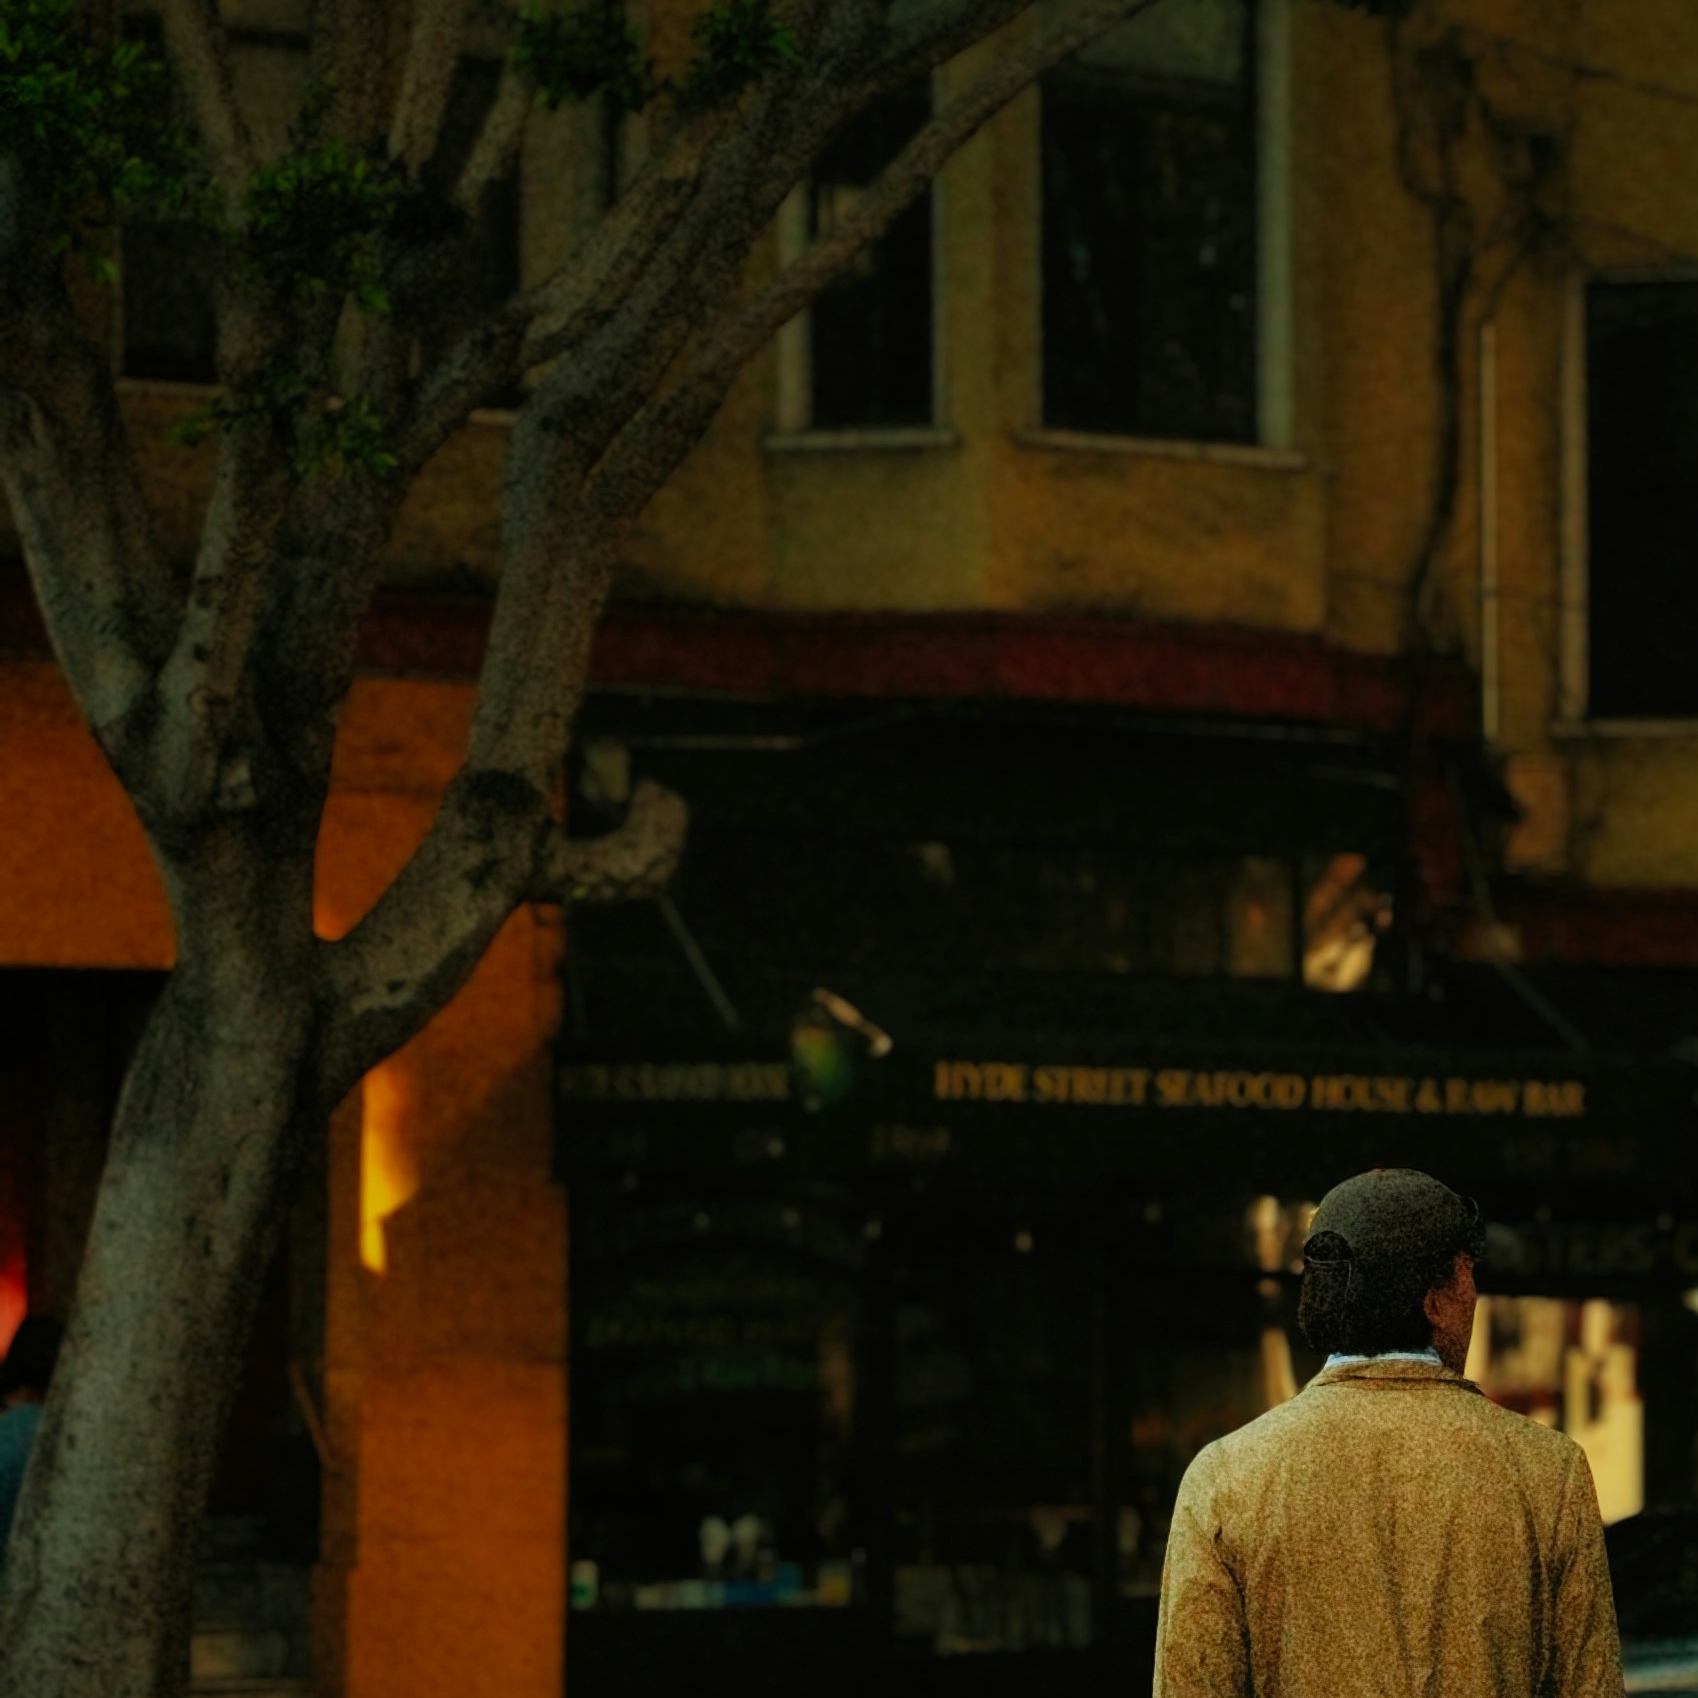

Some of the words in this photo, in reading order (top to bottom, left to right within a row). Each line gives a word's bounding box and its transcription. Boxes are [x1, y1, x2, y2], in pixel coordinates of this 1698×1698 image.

[1156, 1068, 1306, 1112] SEAFOOD
[1310, 1074, 1413, 1114] HOUSE
[1521, 1080, 1588, 1118] BAR
